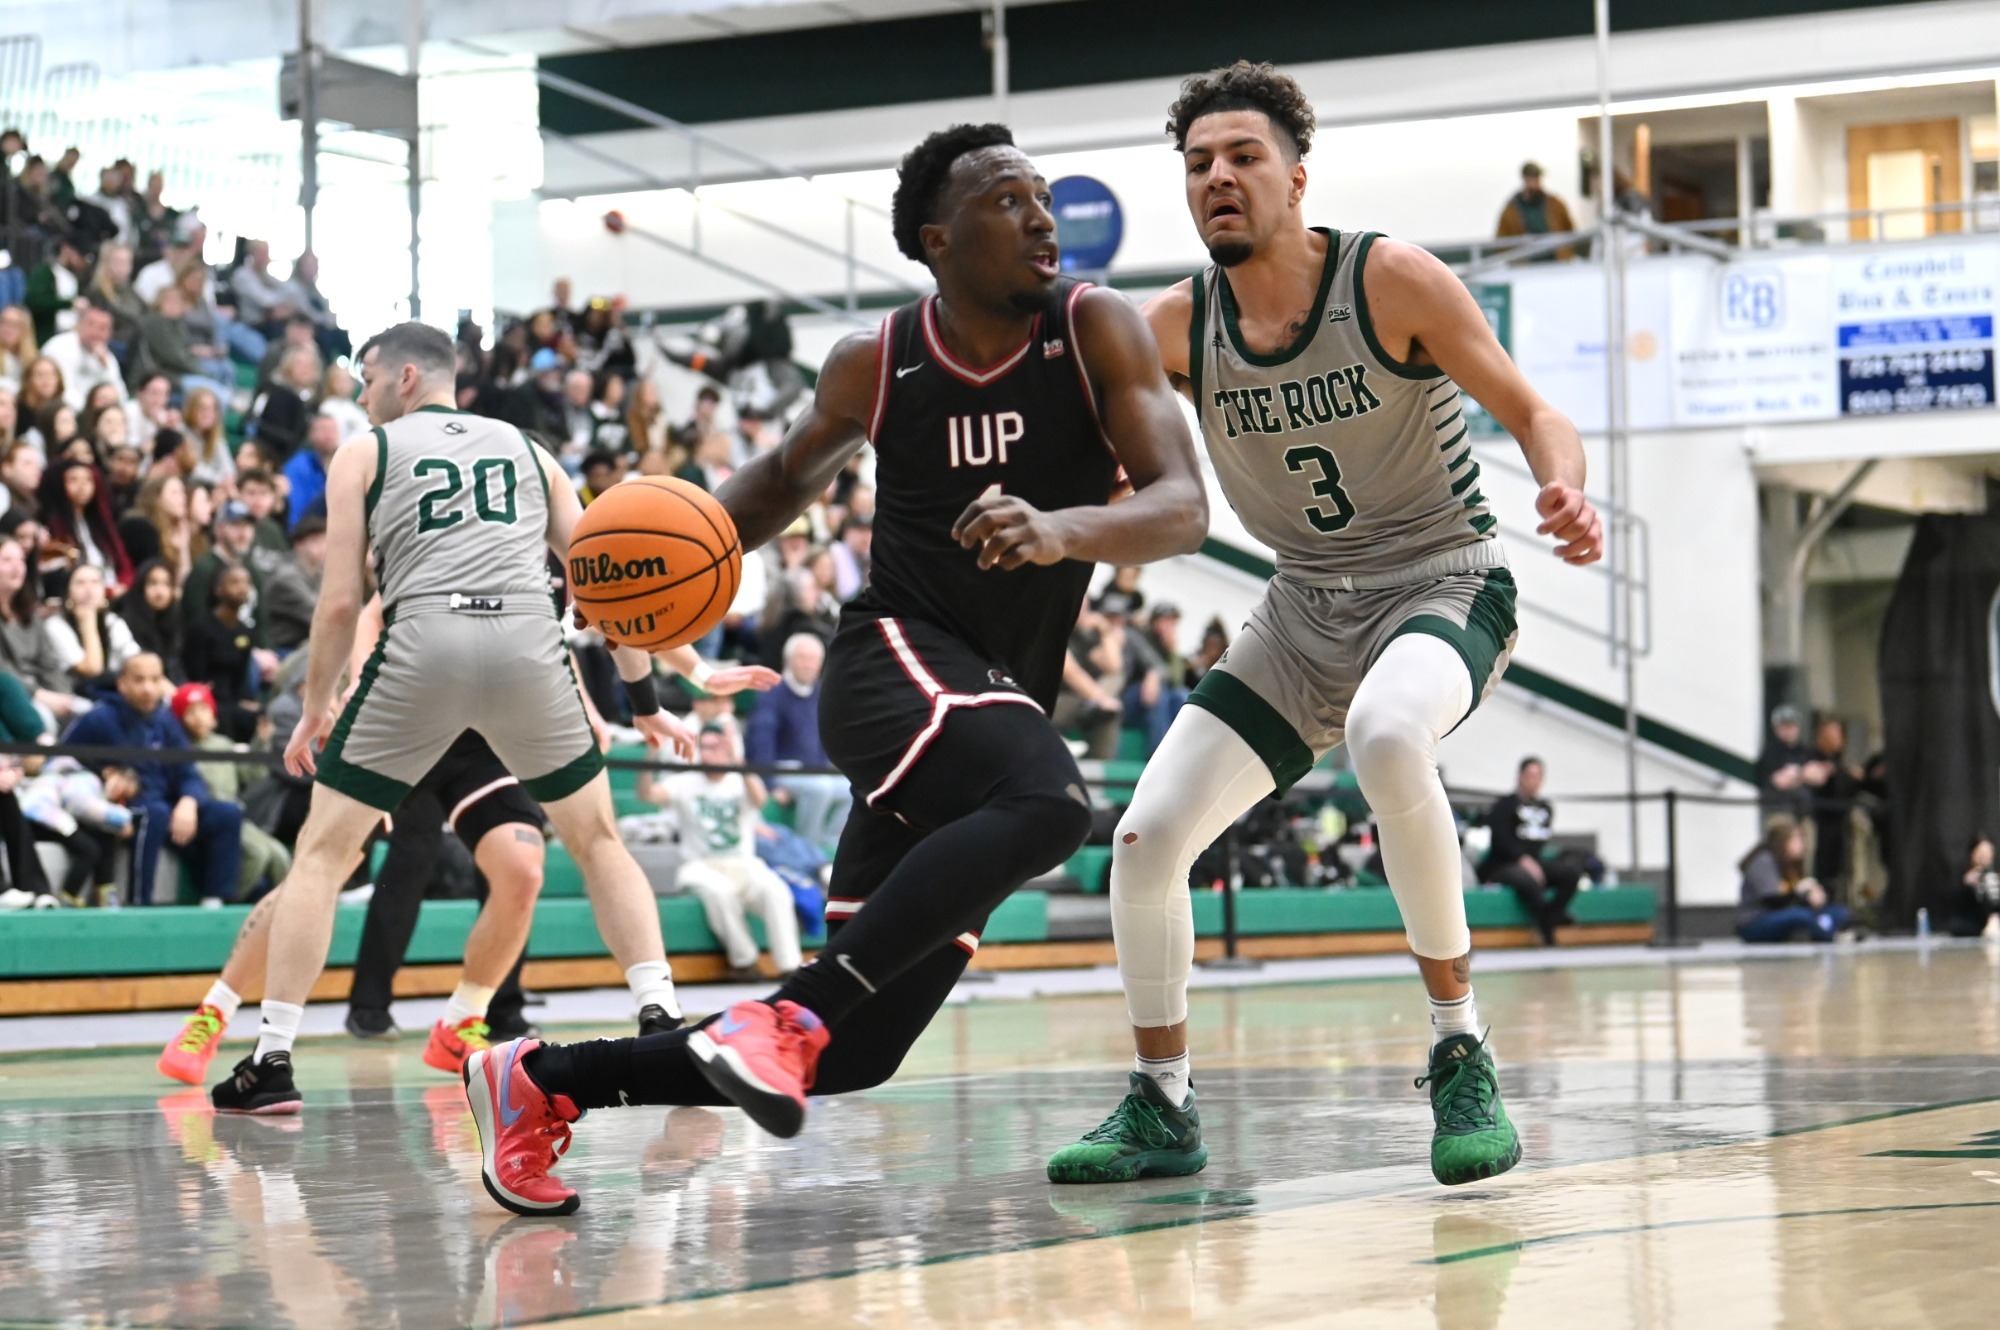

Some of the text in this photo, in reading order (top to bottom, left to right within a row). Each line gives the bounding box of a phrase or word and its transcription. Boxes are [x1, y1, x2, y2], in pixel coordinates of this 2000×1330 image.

[1328, 306, 1350, 319] PSAC
[1728, 274, 1776, 329] RB
[1213, 363, 1382, 438] THE ROCK
[949, 411, 1024, 468] IUP
[411, 456, 518, 536] 20
[1283, 443, 1357, 534] 3
[570, 553, 667, 587] Wilson
